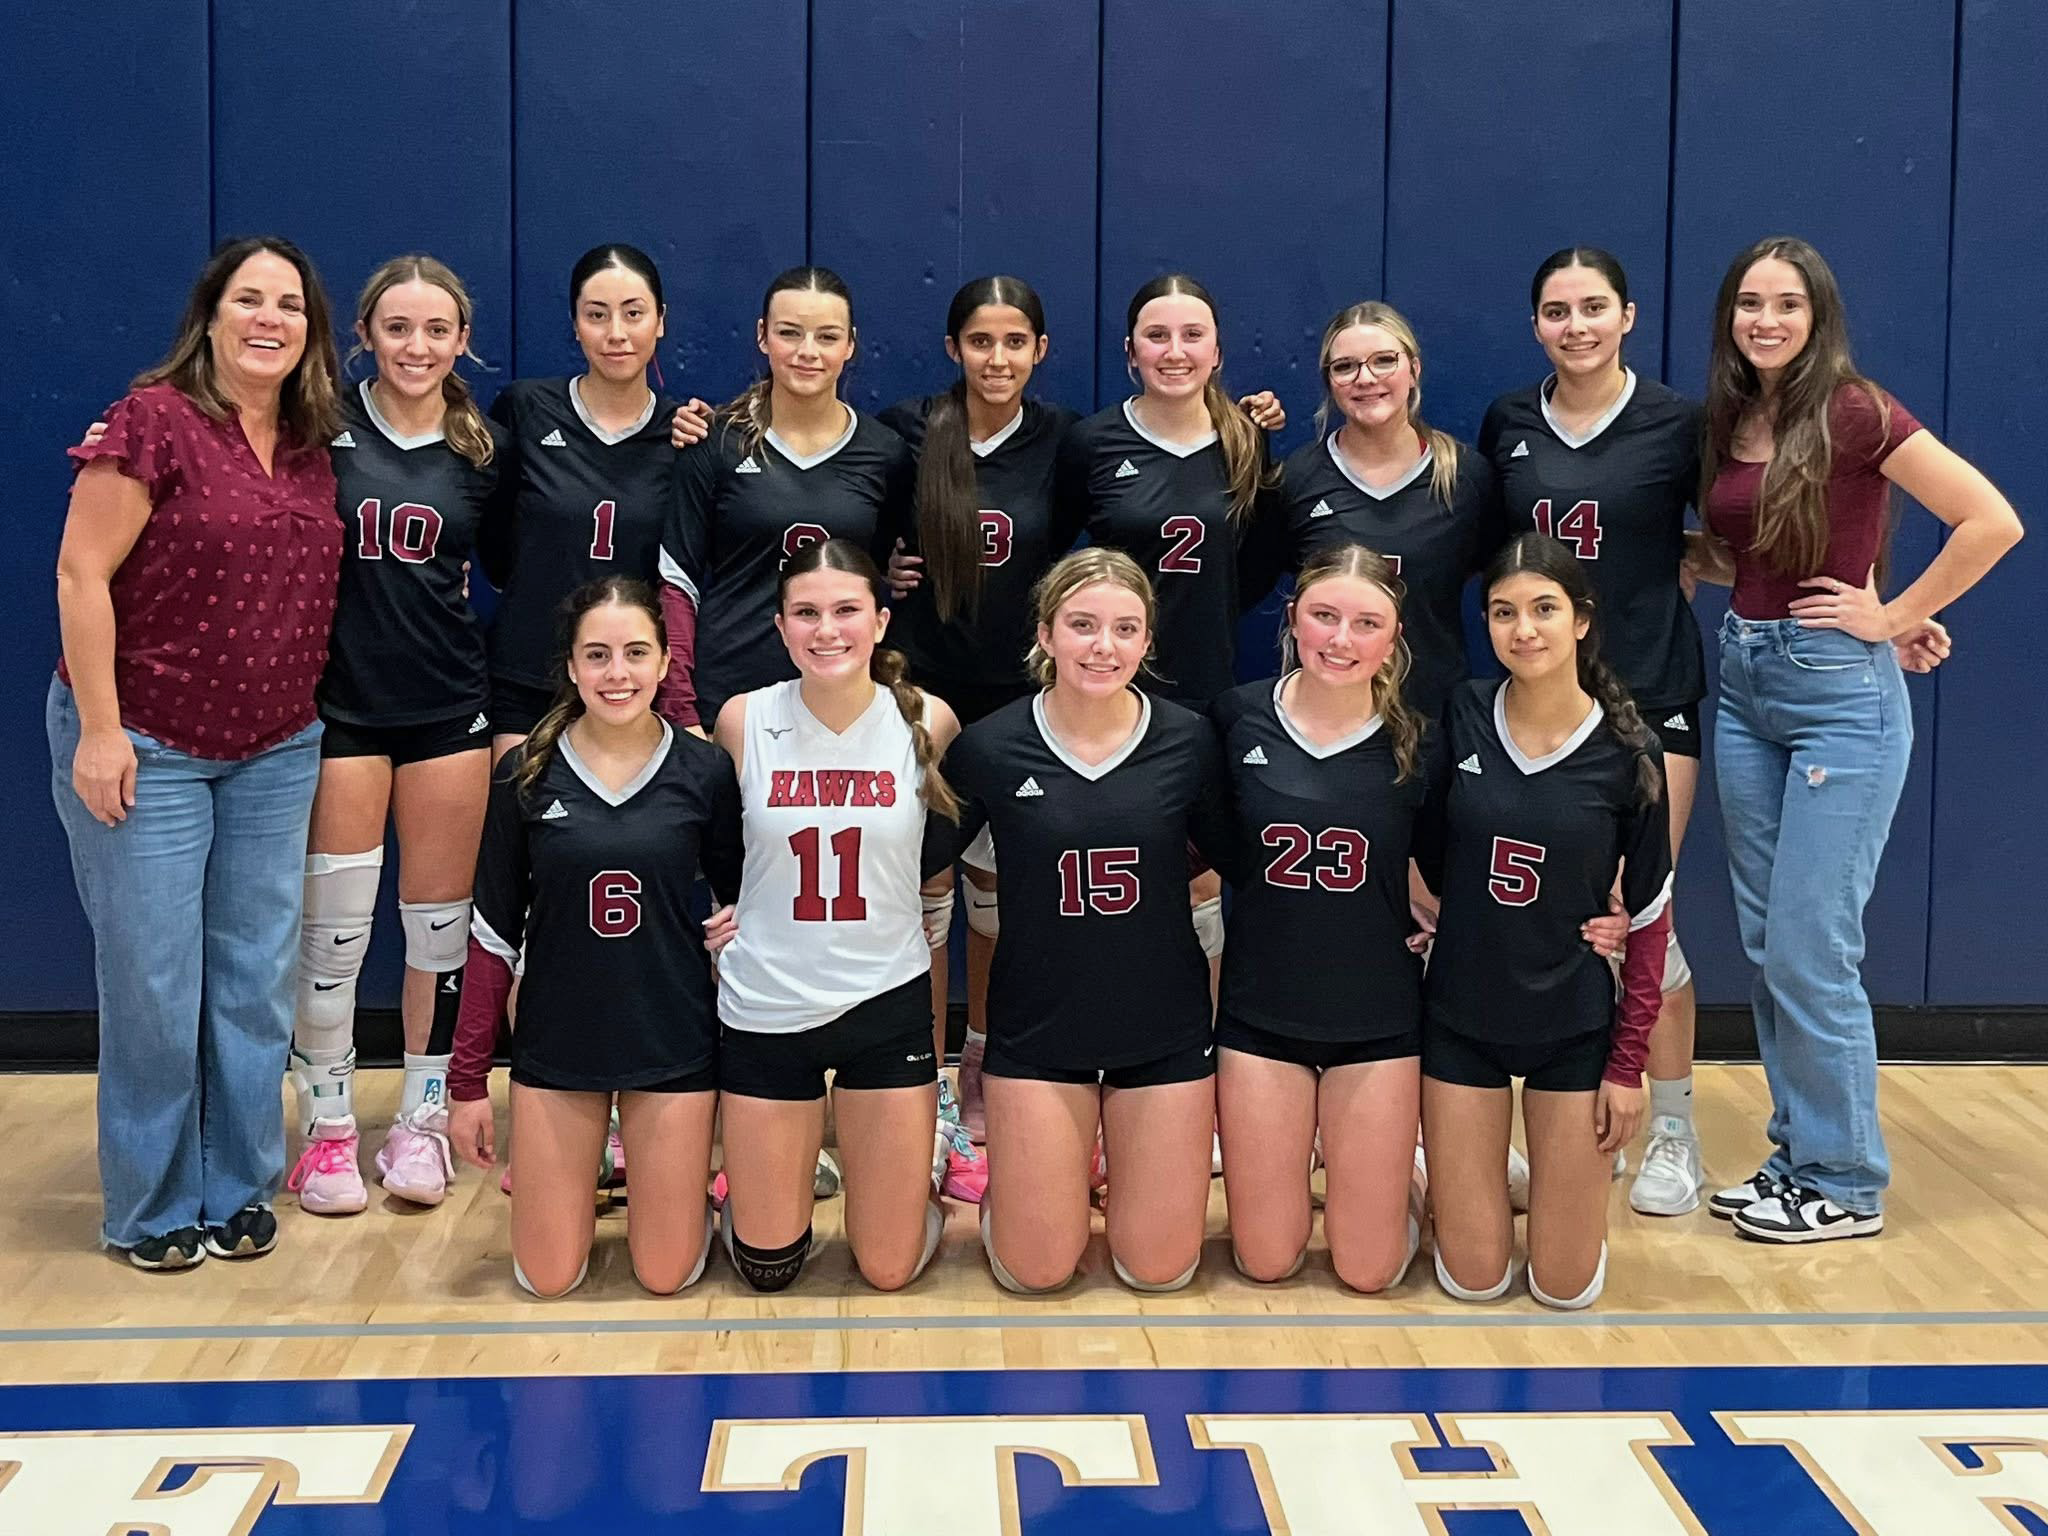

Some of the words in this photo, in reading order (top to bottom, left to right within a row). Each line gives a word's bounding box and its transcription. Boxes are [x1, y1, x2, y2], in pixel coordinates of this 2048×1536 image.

[357, 498, 443, 564] 10
[590, 500, 616, 561] 1
[1159, 515, 1205, 573] 2
[1532, 499, 1603, 560] 14
[767, 769, 896, 807] HAWKS
[788, 826, 866, 921] 11
[1057, 847, 1140, 916] 15
[1261, 823, 1369, 892] 23
[1488, 836, 1546, 906] 5
[589, 870, 641, 937] 6
